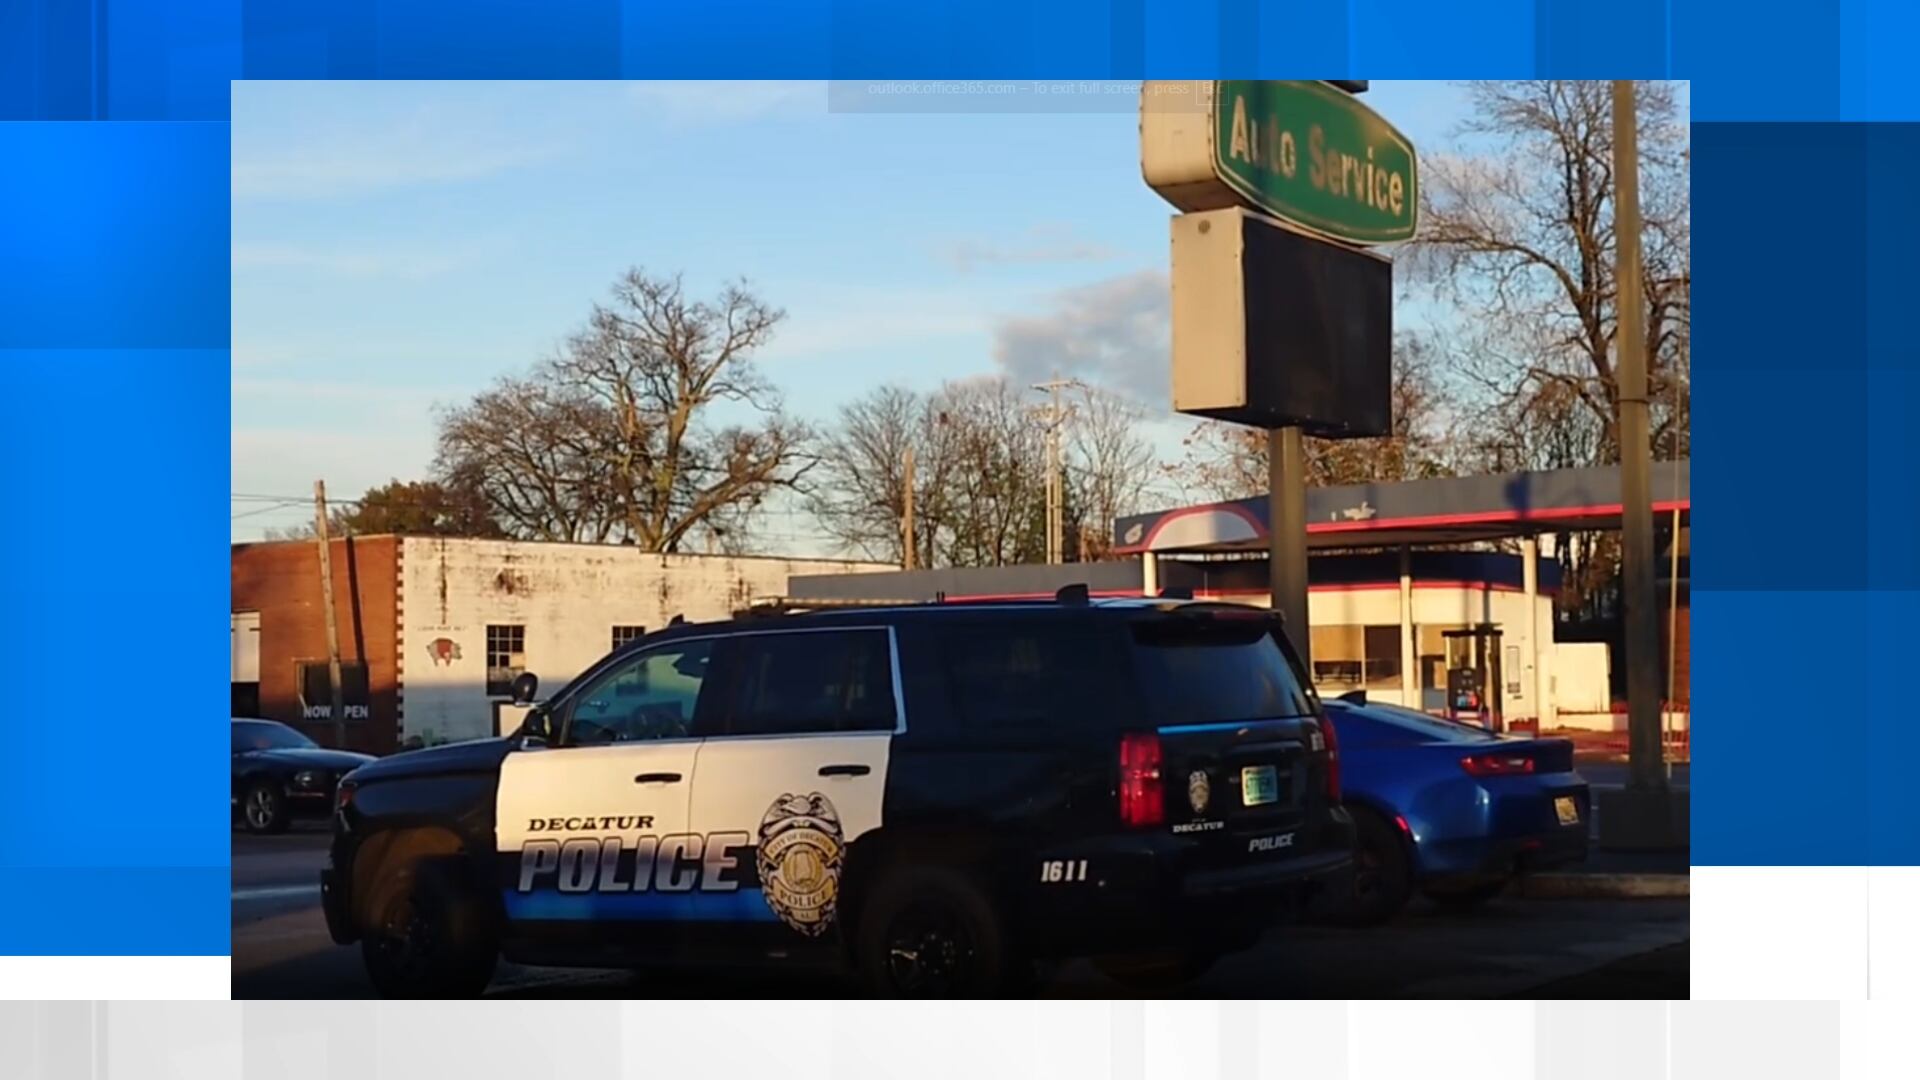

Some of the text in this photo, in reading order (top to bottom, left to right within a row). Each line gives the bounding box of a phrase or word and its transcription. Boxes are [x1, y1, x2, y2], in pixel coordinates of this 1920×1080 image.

[1230, 95, 1404, 216] Auto Service
[303, 705, 369, 718] NOW PEN
[528, 815, 655, 832] DECATUR
[1172, 820, 1225, 833] DECATUR
[1248, 831, 1296, 853] POLICE
[518, 830, 751, 893] POLICE
[1040, 859, 1088, 883] 1611
[779, 888, 826, 907] POLICE
